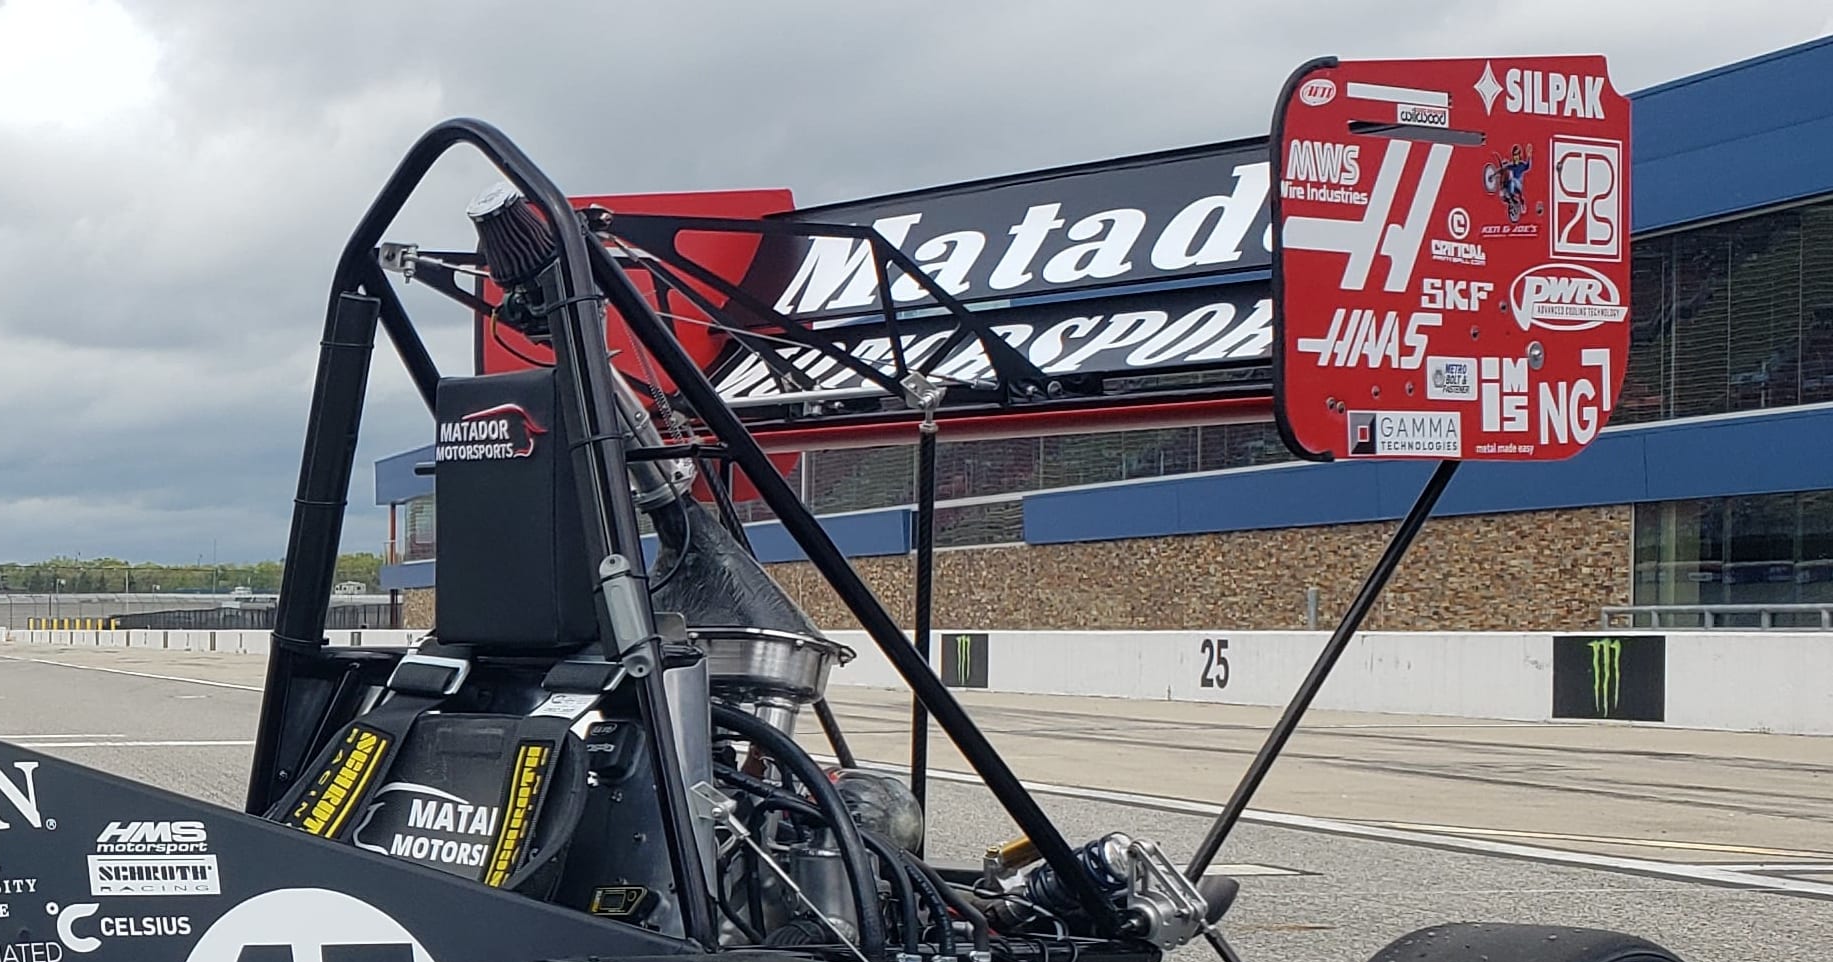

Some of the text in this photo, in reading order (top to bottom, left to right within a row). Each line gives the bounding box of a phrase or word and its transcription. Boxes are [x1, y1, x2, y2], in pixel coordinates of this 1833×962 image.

[1506, 69, 1605, 120] SILPAK
[1400, 108, 1447, 126] wilwood
[1287, 140, 1360, 185] MWS
[1307, 183, 1369, 205] Industries
[771, 161, 1273, 317] Matad
[1421, 278, 1494, 311] SKF
[1518, 276, 1610, 331] PWR
[1537, 304, 1620, 318] ADVANCED COOLING TECHNOLOGY
[1298, 309, 1443, 369] HAAS
[1445, 363, 1467, 375] METRO
[1445, 375, 1461, 385] BOLT
[440, 419, 510, 442] MATADOR
[1380, 416, 1457, 438] GAMMA
[436, 443, 514, 461] MOTORSPORTS
[1381, 441, 1458, 452] TECHNOLOGIES
[1475, 443, 1497, 454] metal
[1497, 443, 1517, 454] made
[1200, 638, 1230, 690] 25
[303, 731, 378, 836] SCHROT
[407, 798, 499, 837] MATA
[96, 821, 207, 843] HMS
[96, 841, 208, 855] motorsport
[390, 834, 489, 867] MOTORS
[98, 865, 210, 882] SCHROTH
[99, 884, 210, 893] RACING
[100, 917, 192, 937] CELSIUS
